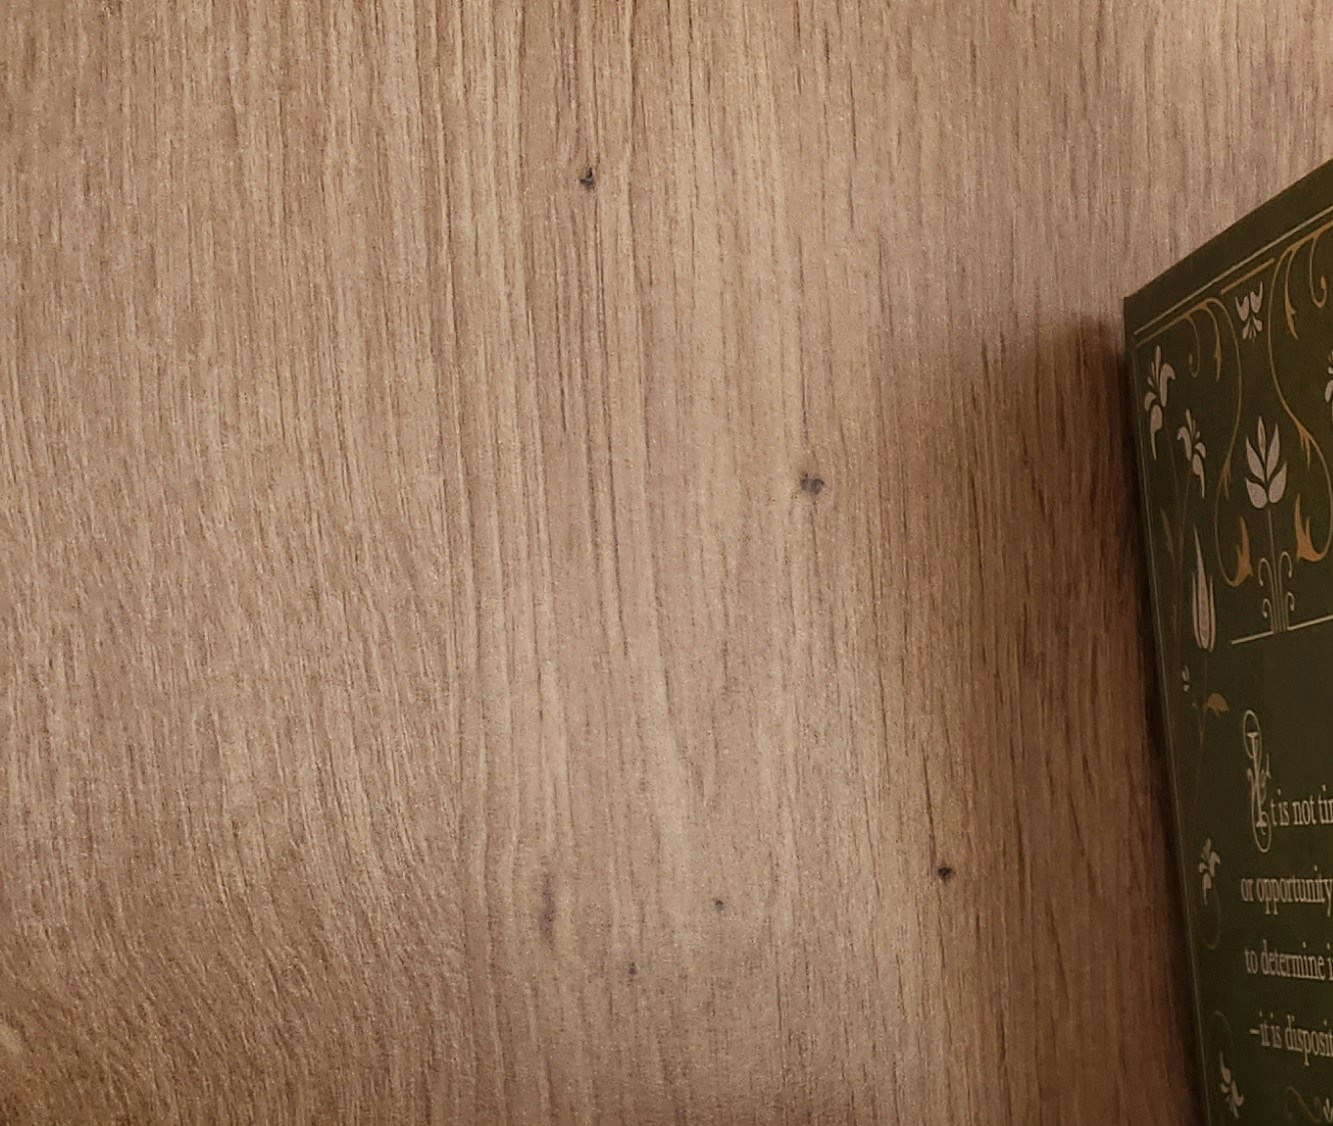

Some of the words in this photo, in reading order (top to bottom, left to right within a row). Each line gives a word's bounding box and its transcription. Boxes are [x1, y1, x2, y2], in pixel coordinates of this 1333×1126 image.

[1278, 788, 1290, 827] is
[1292, 795, 1317, 826] not
[1240, 878, 1254, 902] or
[1256, 864, 1333, 917] opportunity
[1245, 947, 1258, 975] to
[1261, 938, 1327, 981] determine
[1270, 1011, 1282, 1049] is
